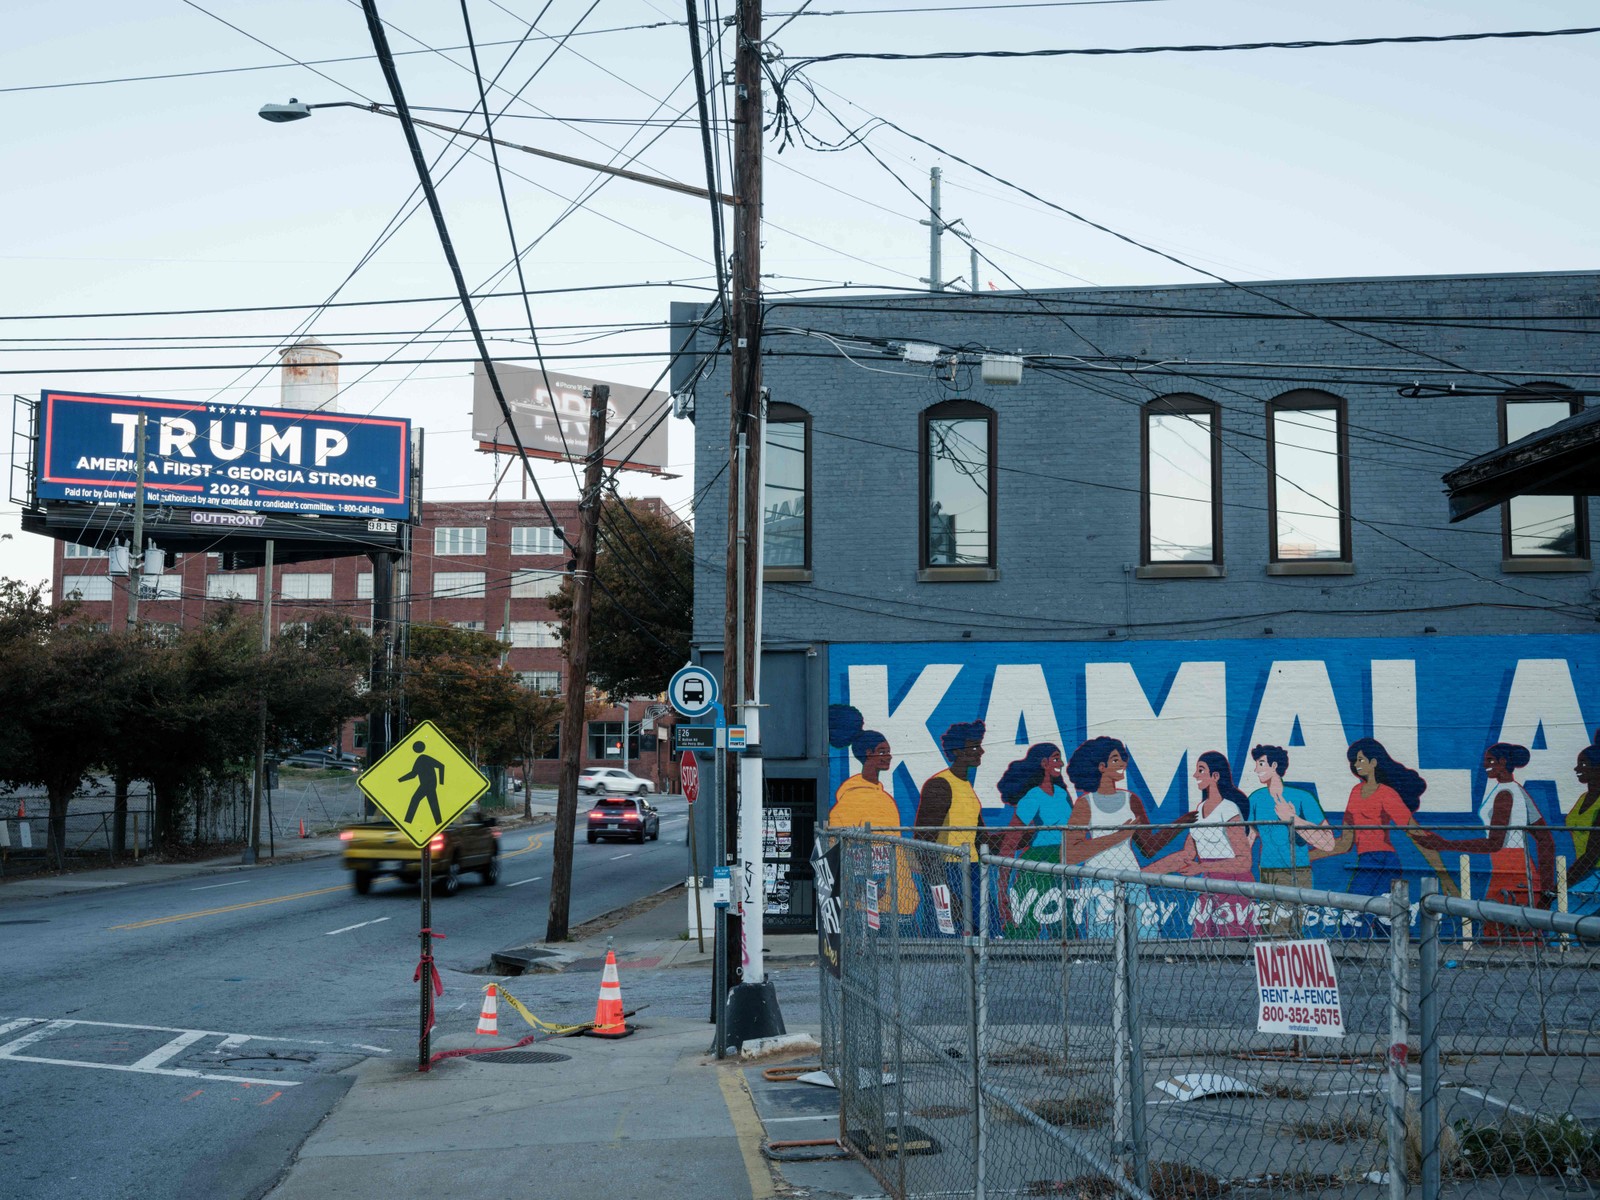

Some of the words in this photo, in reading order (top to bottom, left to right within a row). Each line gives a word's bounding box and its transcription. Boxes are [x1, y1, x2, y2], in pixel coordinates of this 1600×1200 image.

[111, 412, 348, 467] TRUMP
[163, 462, 212, 477] FIRST
[228, 466, 304, 483] GEORGIA
[308, 471, 377, 488] STRONG
[65, 488, 81, 497] Paid
[82, 488, 92, 497] for
[93, 489, 103, 500] by
[104, 490, 117, 498] Dan
[147, 492, 159, 501] Not
[198, 495, 206, 504] by
[208, 498, 219, 506] any
[221, 497, 252, 506] candidate
[210, 483, 250, 496] 2024
[193, 513, 262, 525] OUTFRONT
[368, 522, 396, 531] 9815
[682, 729, 689, 737] 26
[848, 658, 1591, 814] KAMALA
[683, 766, 697, 786] STOP
[1010, 887, 1115, 924] VOTE
[1256, 944, 1336, 988] NATIONAL
[1262, 989, 1338, 1005] RENT-A-FENCE
[1263, 1006, 1340, 1026] 800-352-5675
